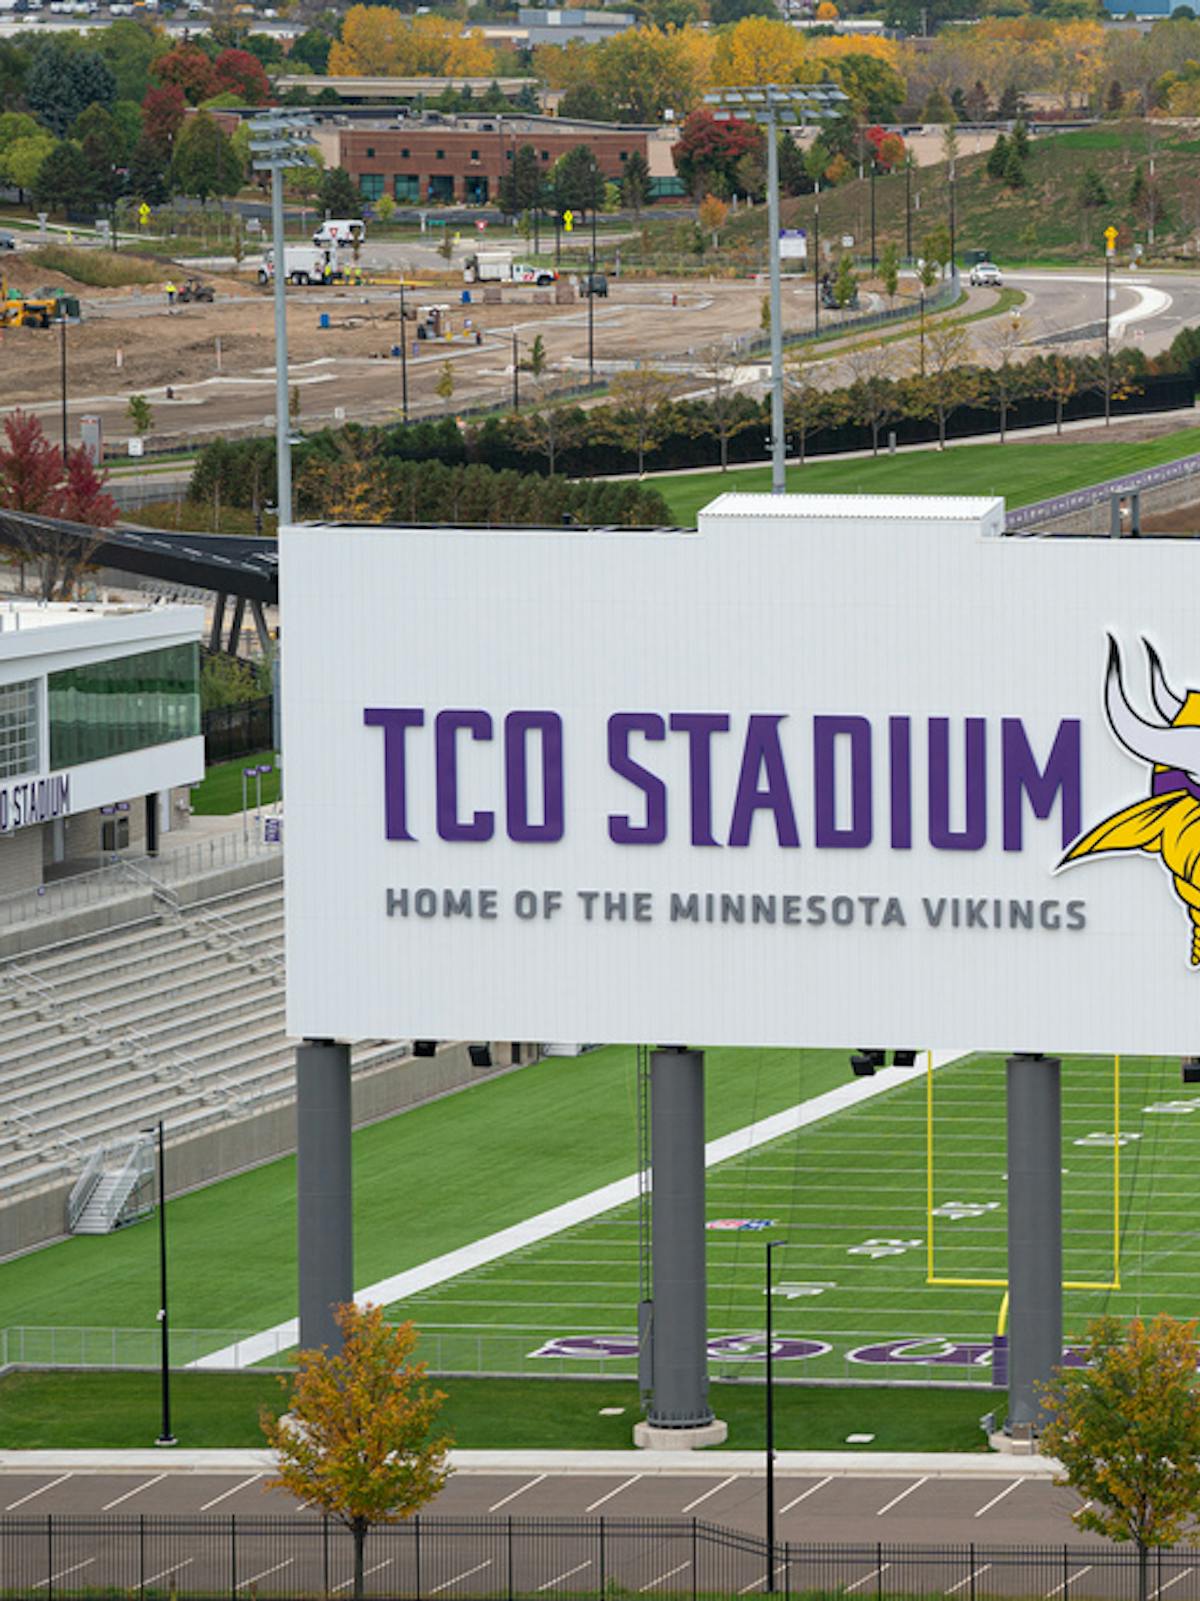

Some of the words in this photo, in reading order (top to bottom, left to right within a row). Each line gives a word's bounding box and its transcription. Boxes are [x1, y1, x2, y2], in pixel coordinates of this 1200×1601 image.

[13, 773, 70, 827] STADIUM
[364, 708, 565, 846] TCO
[607, 713, 1083, 854] STADIUM
[386, 887, 498, 920] HOME
[514, 890, 563, 921] OF
[577, 891, 653, 923] THE
[669, 892, 907, 928] MINNESOTA
[921, 897, 1086, 932] VIKINGS
